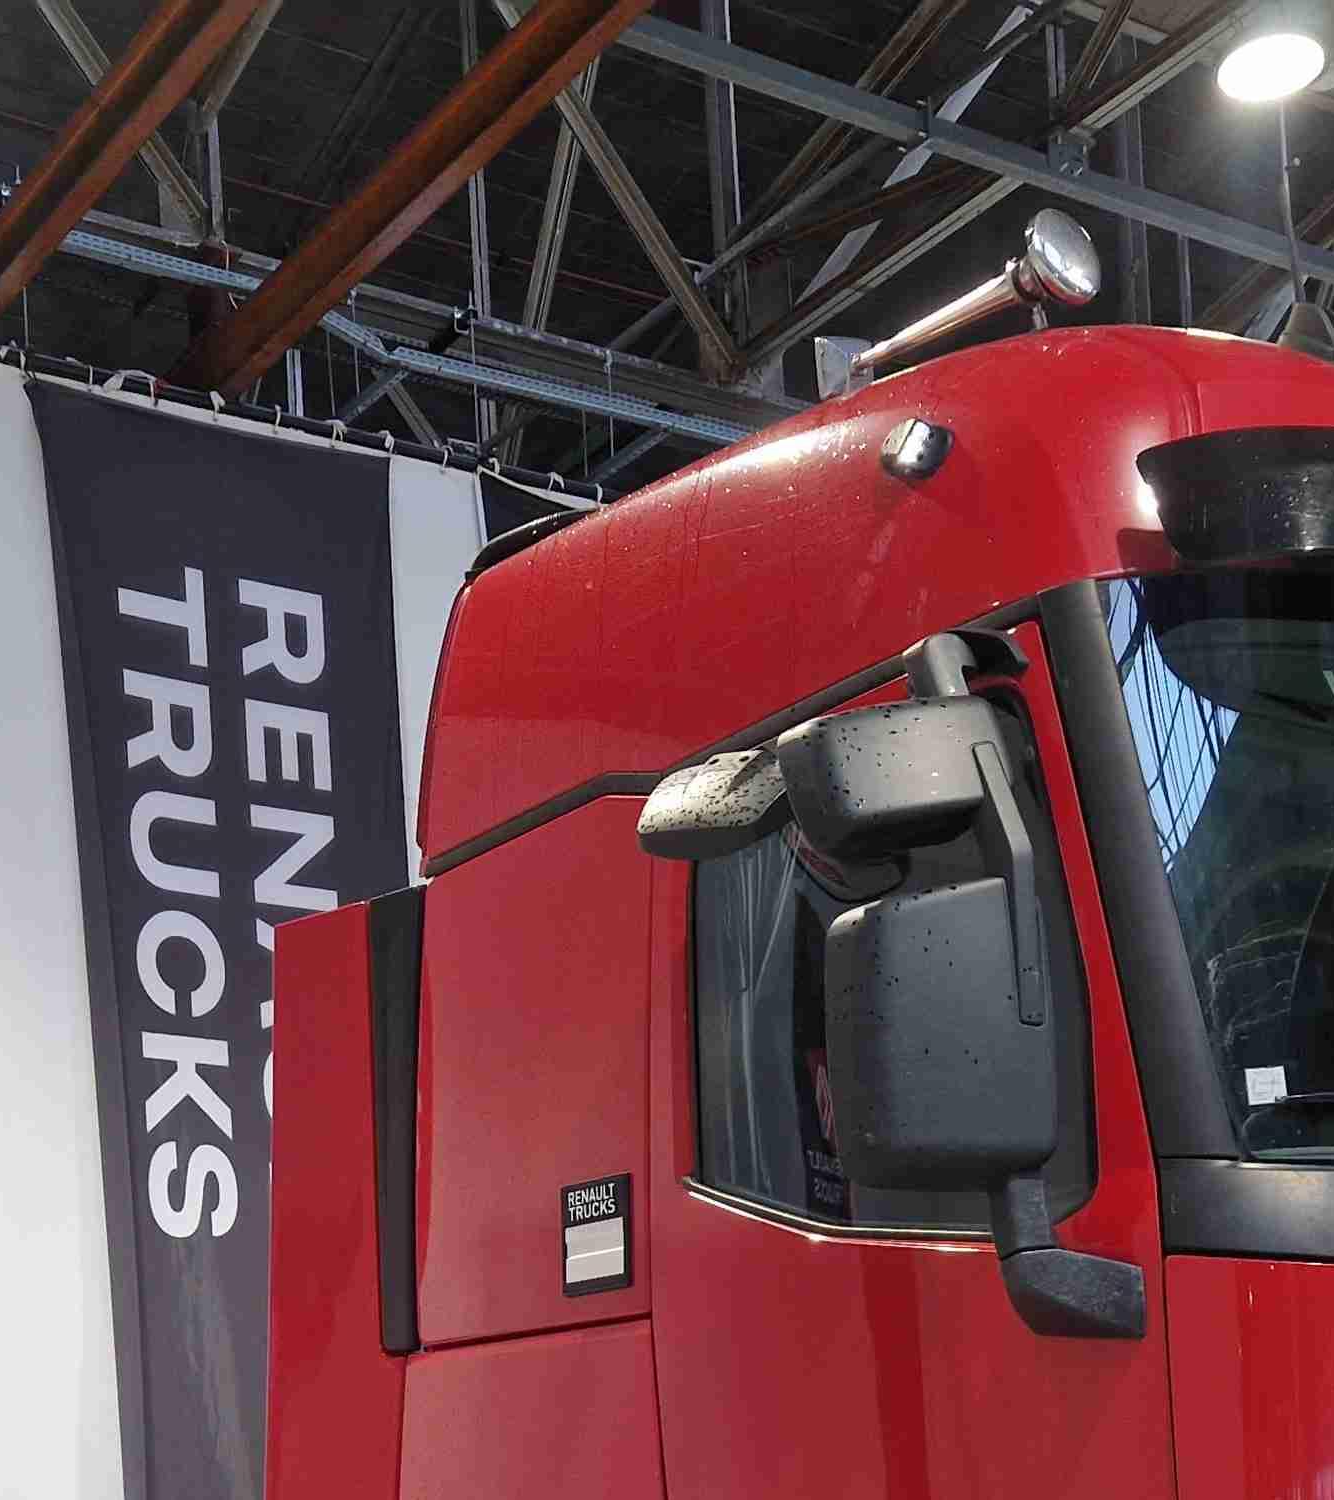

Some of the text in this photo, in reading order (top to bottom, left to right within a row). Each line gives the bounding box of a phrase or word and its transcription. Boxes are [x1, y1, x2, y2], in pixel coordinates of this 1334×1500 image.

[118, 566, 238, 1239] TRUCKS
[568, 1183, 615, 1208] RENAULT
[569, 1199, 616, 1222] TRUCKS
